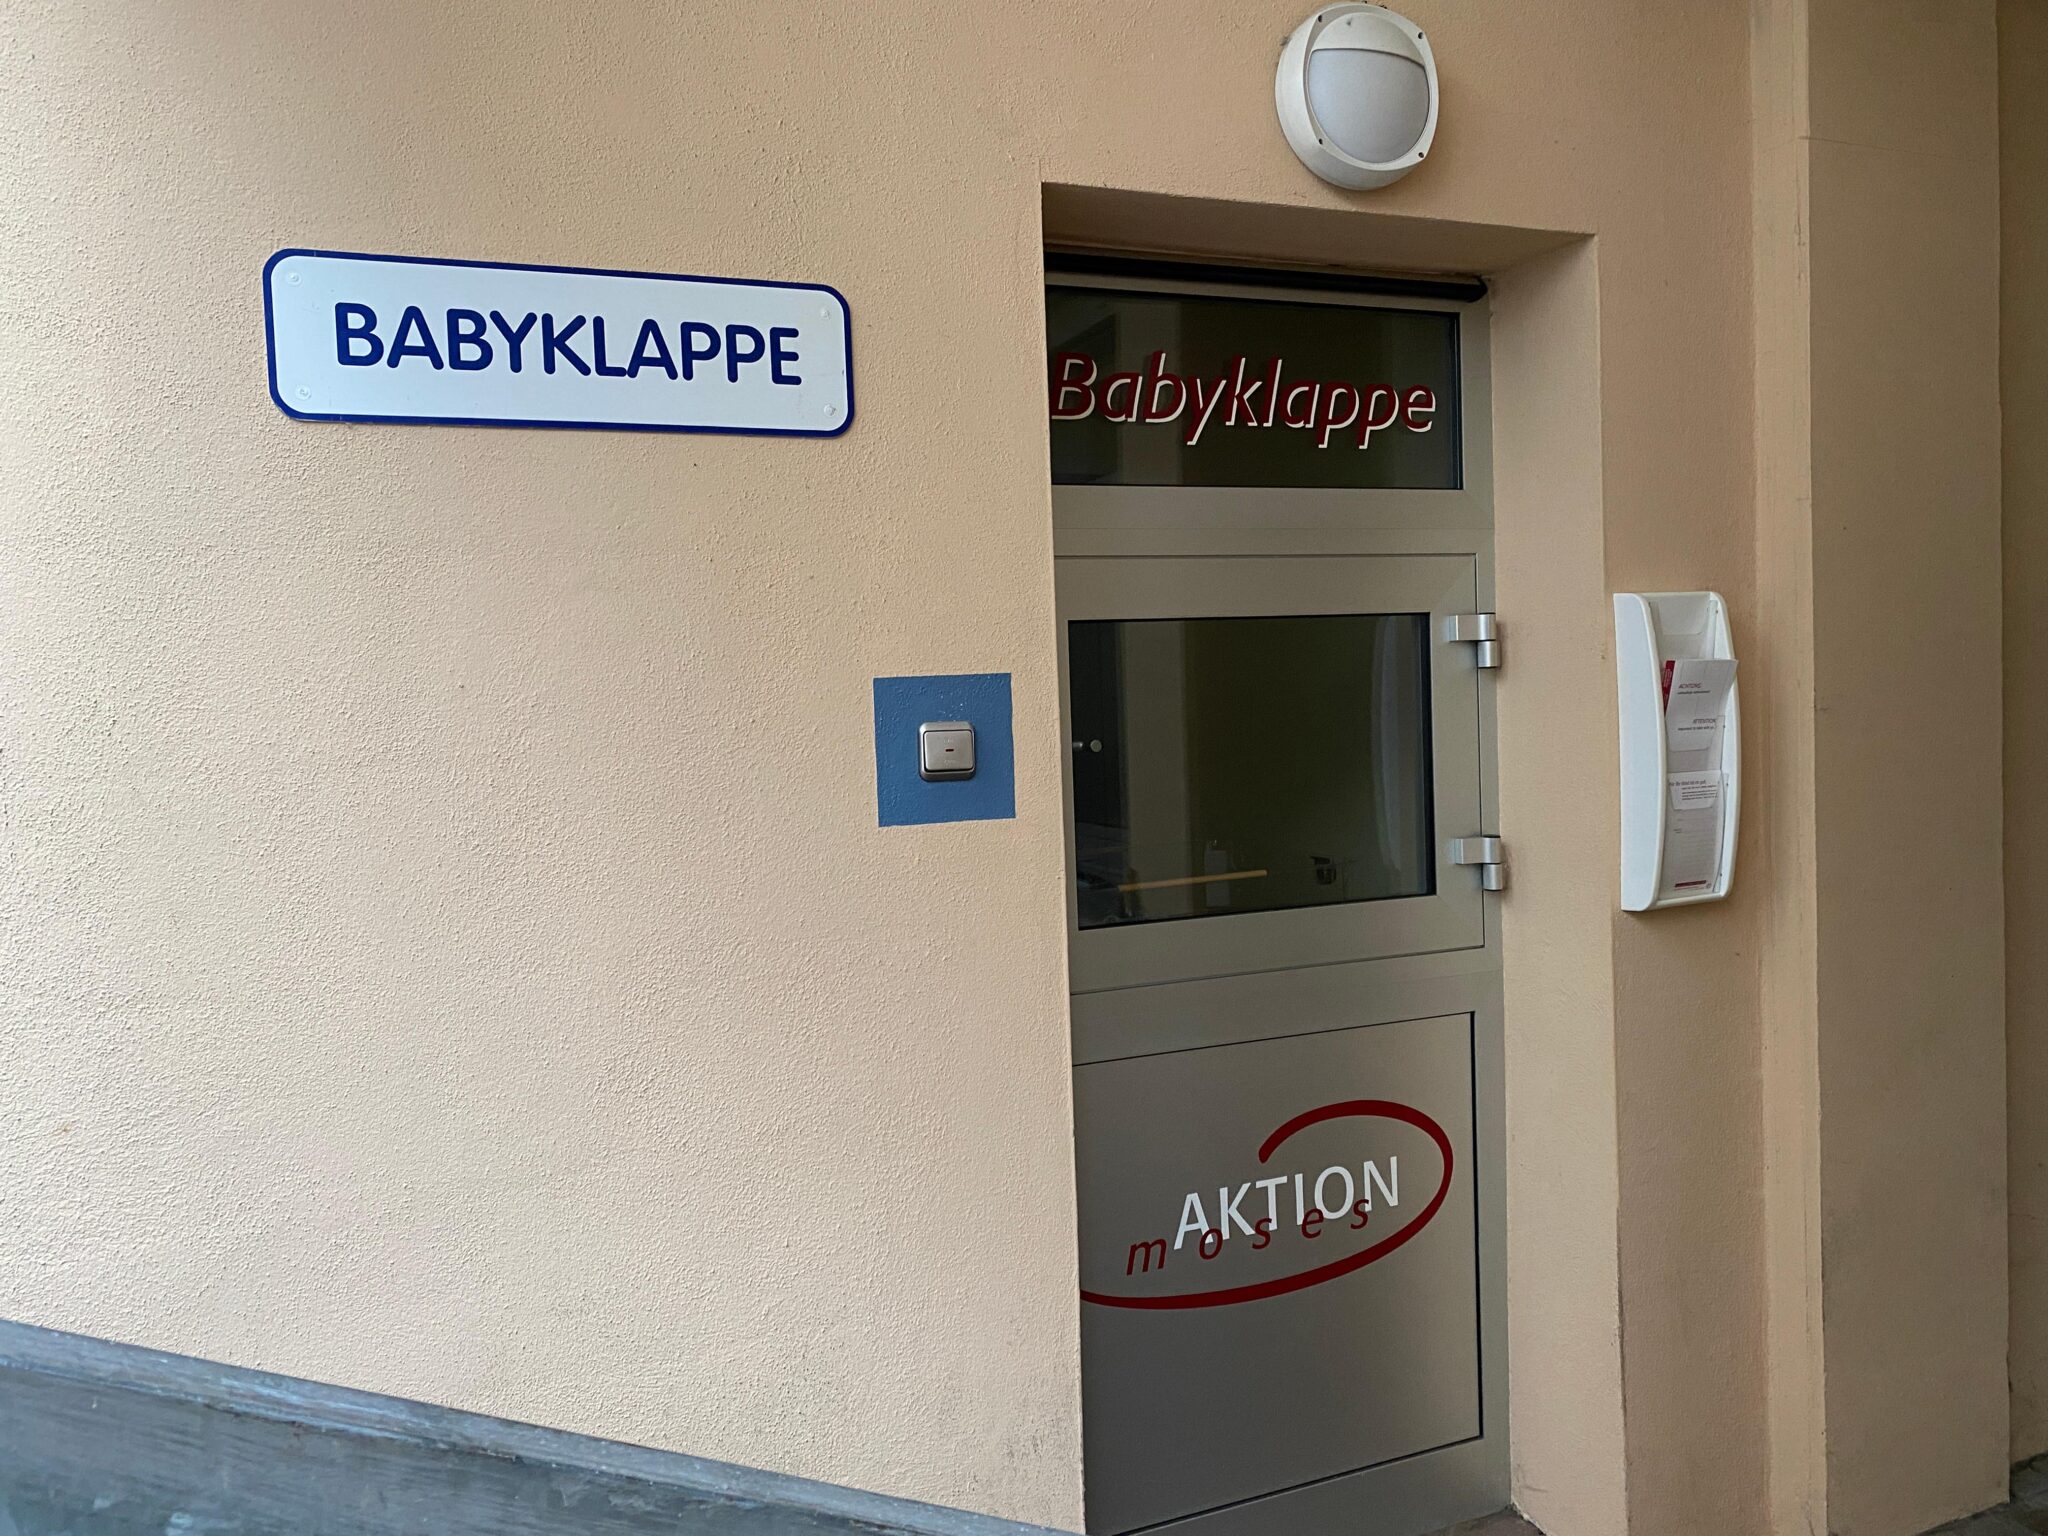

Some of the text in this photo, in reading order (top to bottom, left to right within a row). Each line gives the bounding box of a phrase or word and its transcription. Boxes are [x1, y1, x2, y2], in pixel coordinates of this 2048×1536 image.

[335, 302, 802, 386] BABYKLAPPE
[1051, 349, 1436, 450] Babyklappe
[1126, 1198, 1370, 1276] moses
[1173, 1156, 1399, 1250] AKTION
